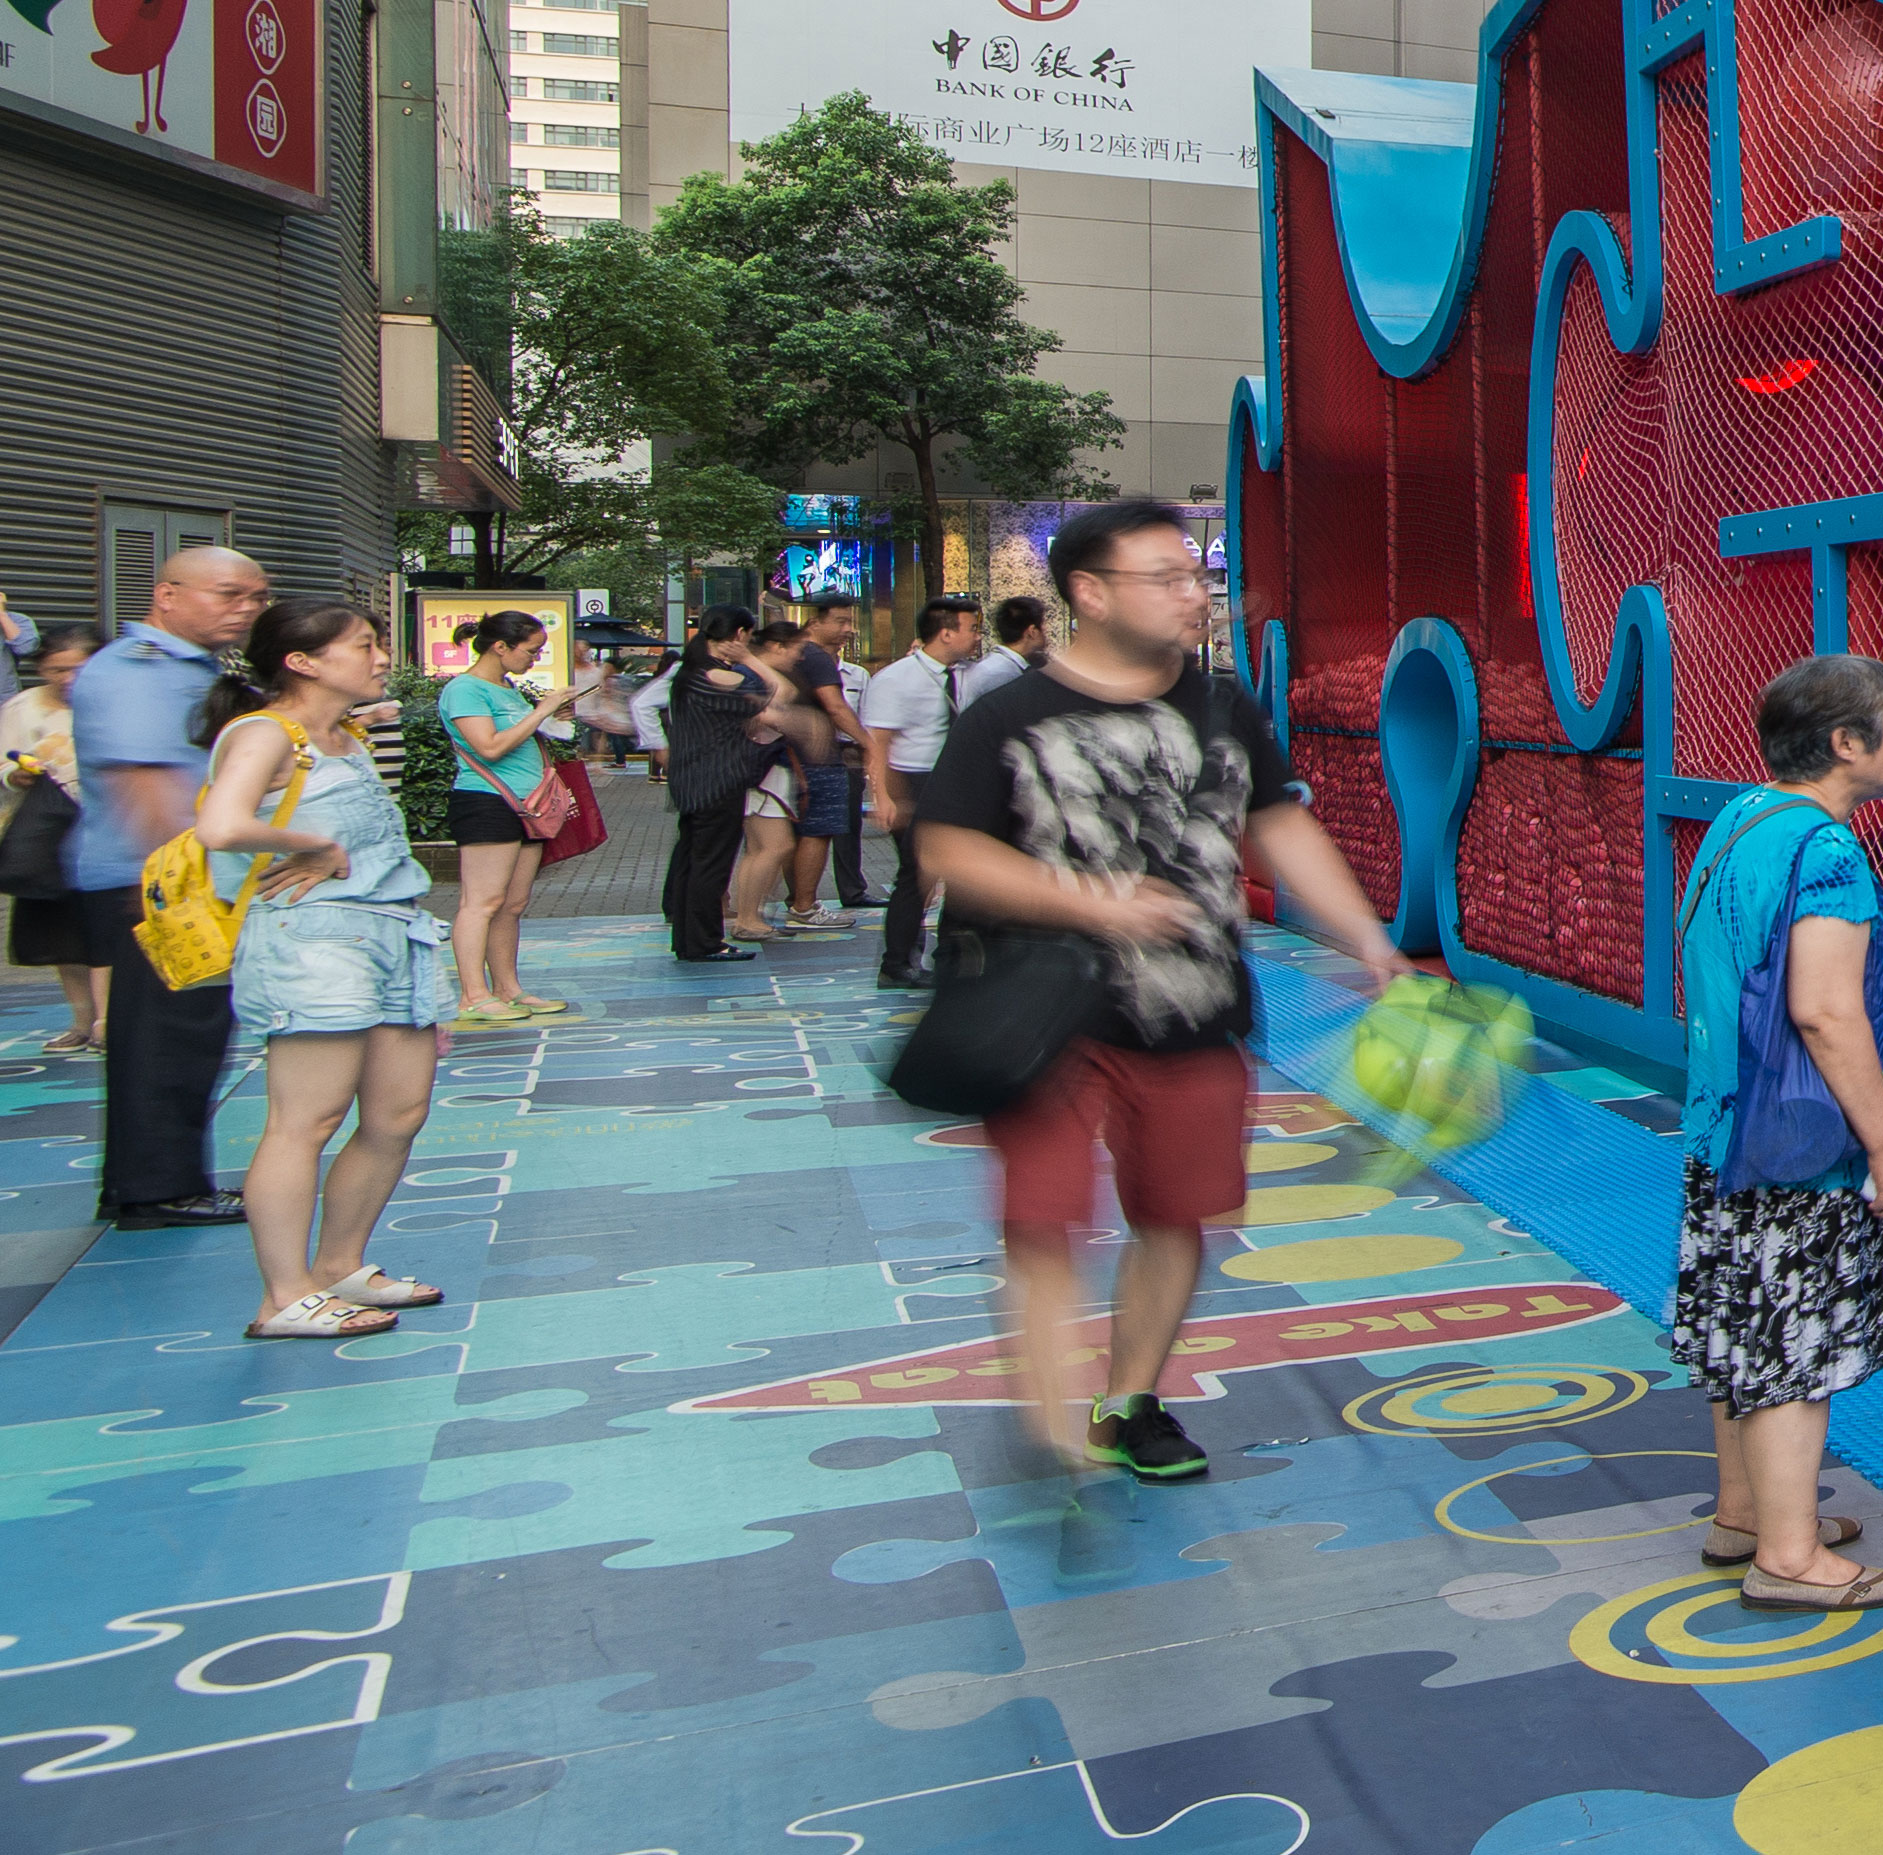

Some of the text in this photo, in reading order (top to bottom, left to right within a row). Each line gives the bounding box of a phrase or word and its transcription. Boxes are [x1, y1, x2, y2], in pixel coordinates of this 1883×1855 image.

[934, 77, 1136, 113] BANK OF CHINA
[1277, 1293, 1594, 1342] Take
